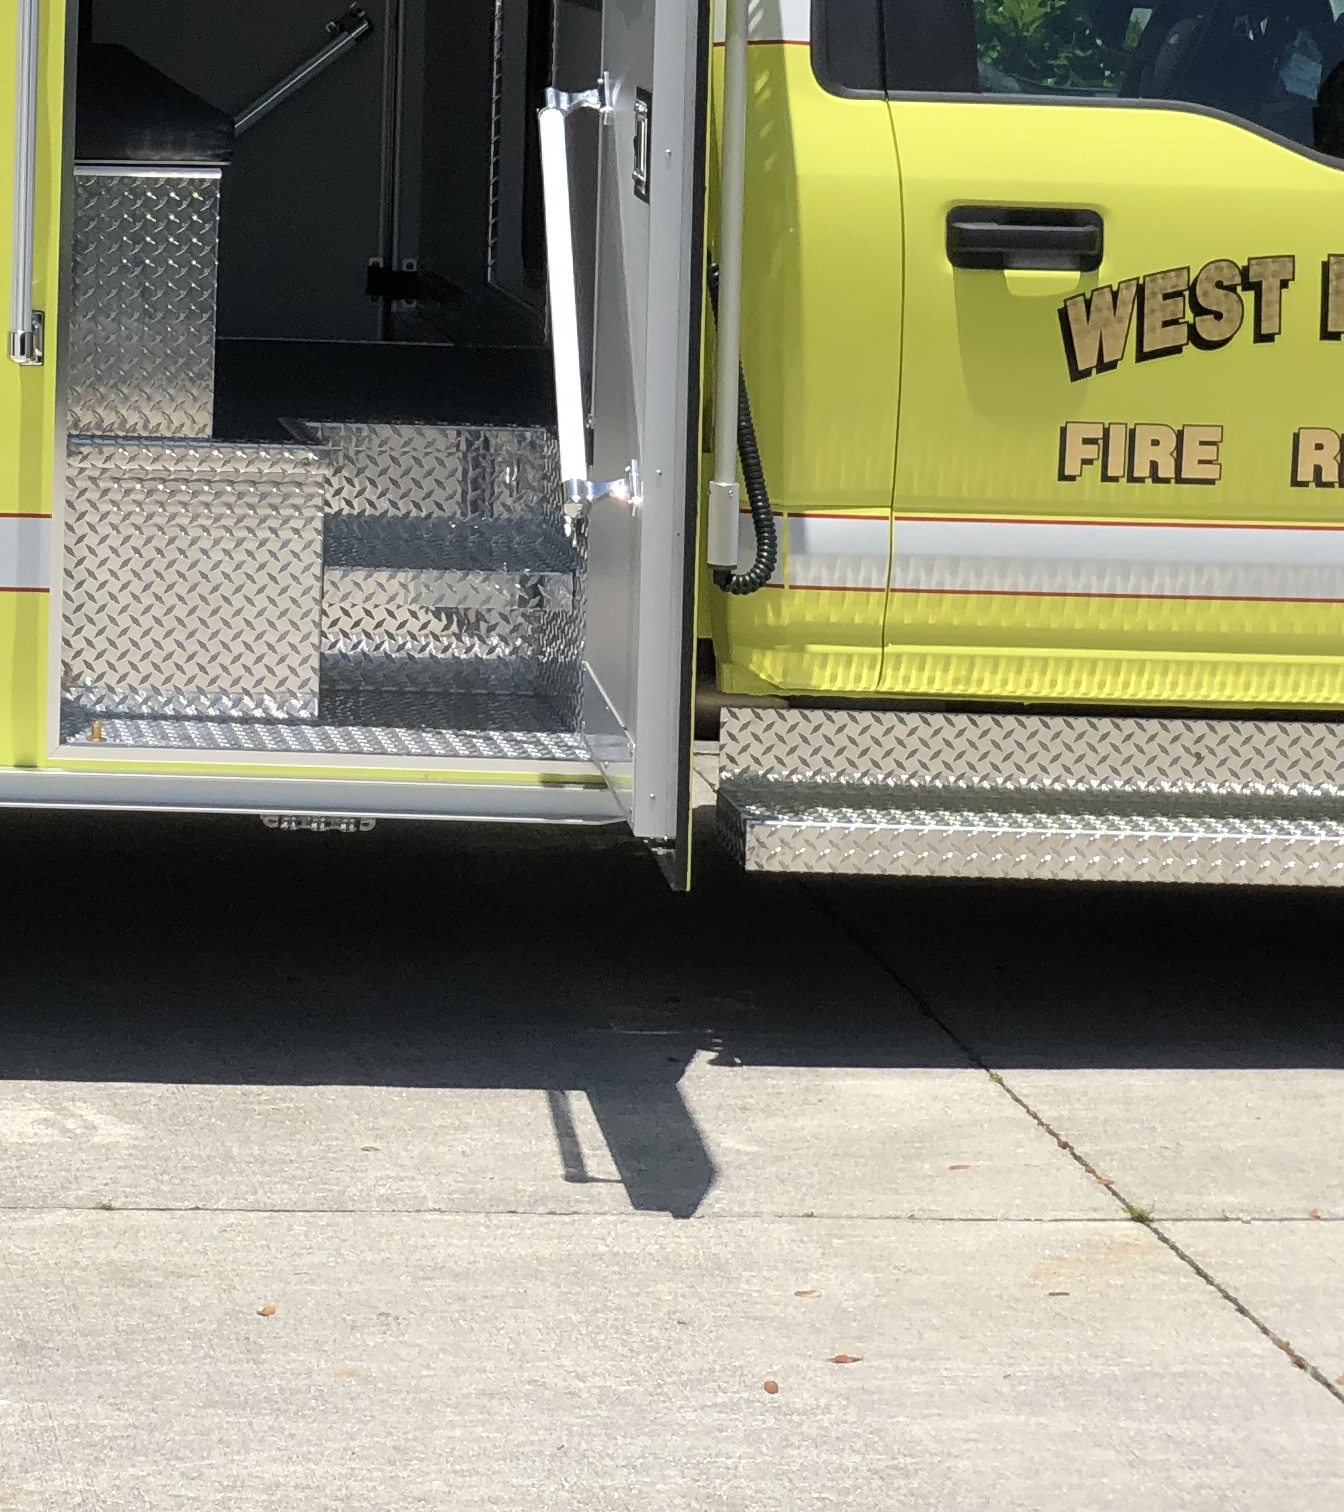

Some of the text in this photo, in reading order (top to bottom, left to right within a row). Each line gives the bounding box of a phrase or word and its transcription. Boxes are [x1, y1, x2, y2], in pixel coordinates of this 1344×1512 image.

[1058, 254, 1296, 383] WEST
[1058, 421, 1344, 488] FIRE R
